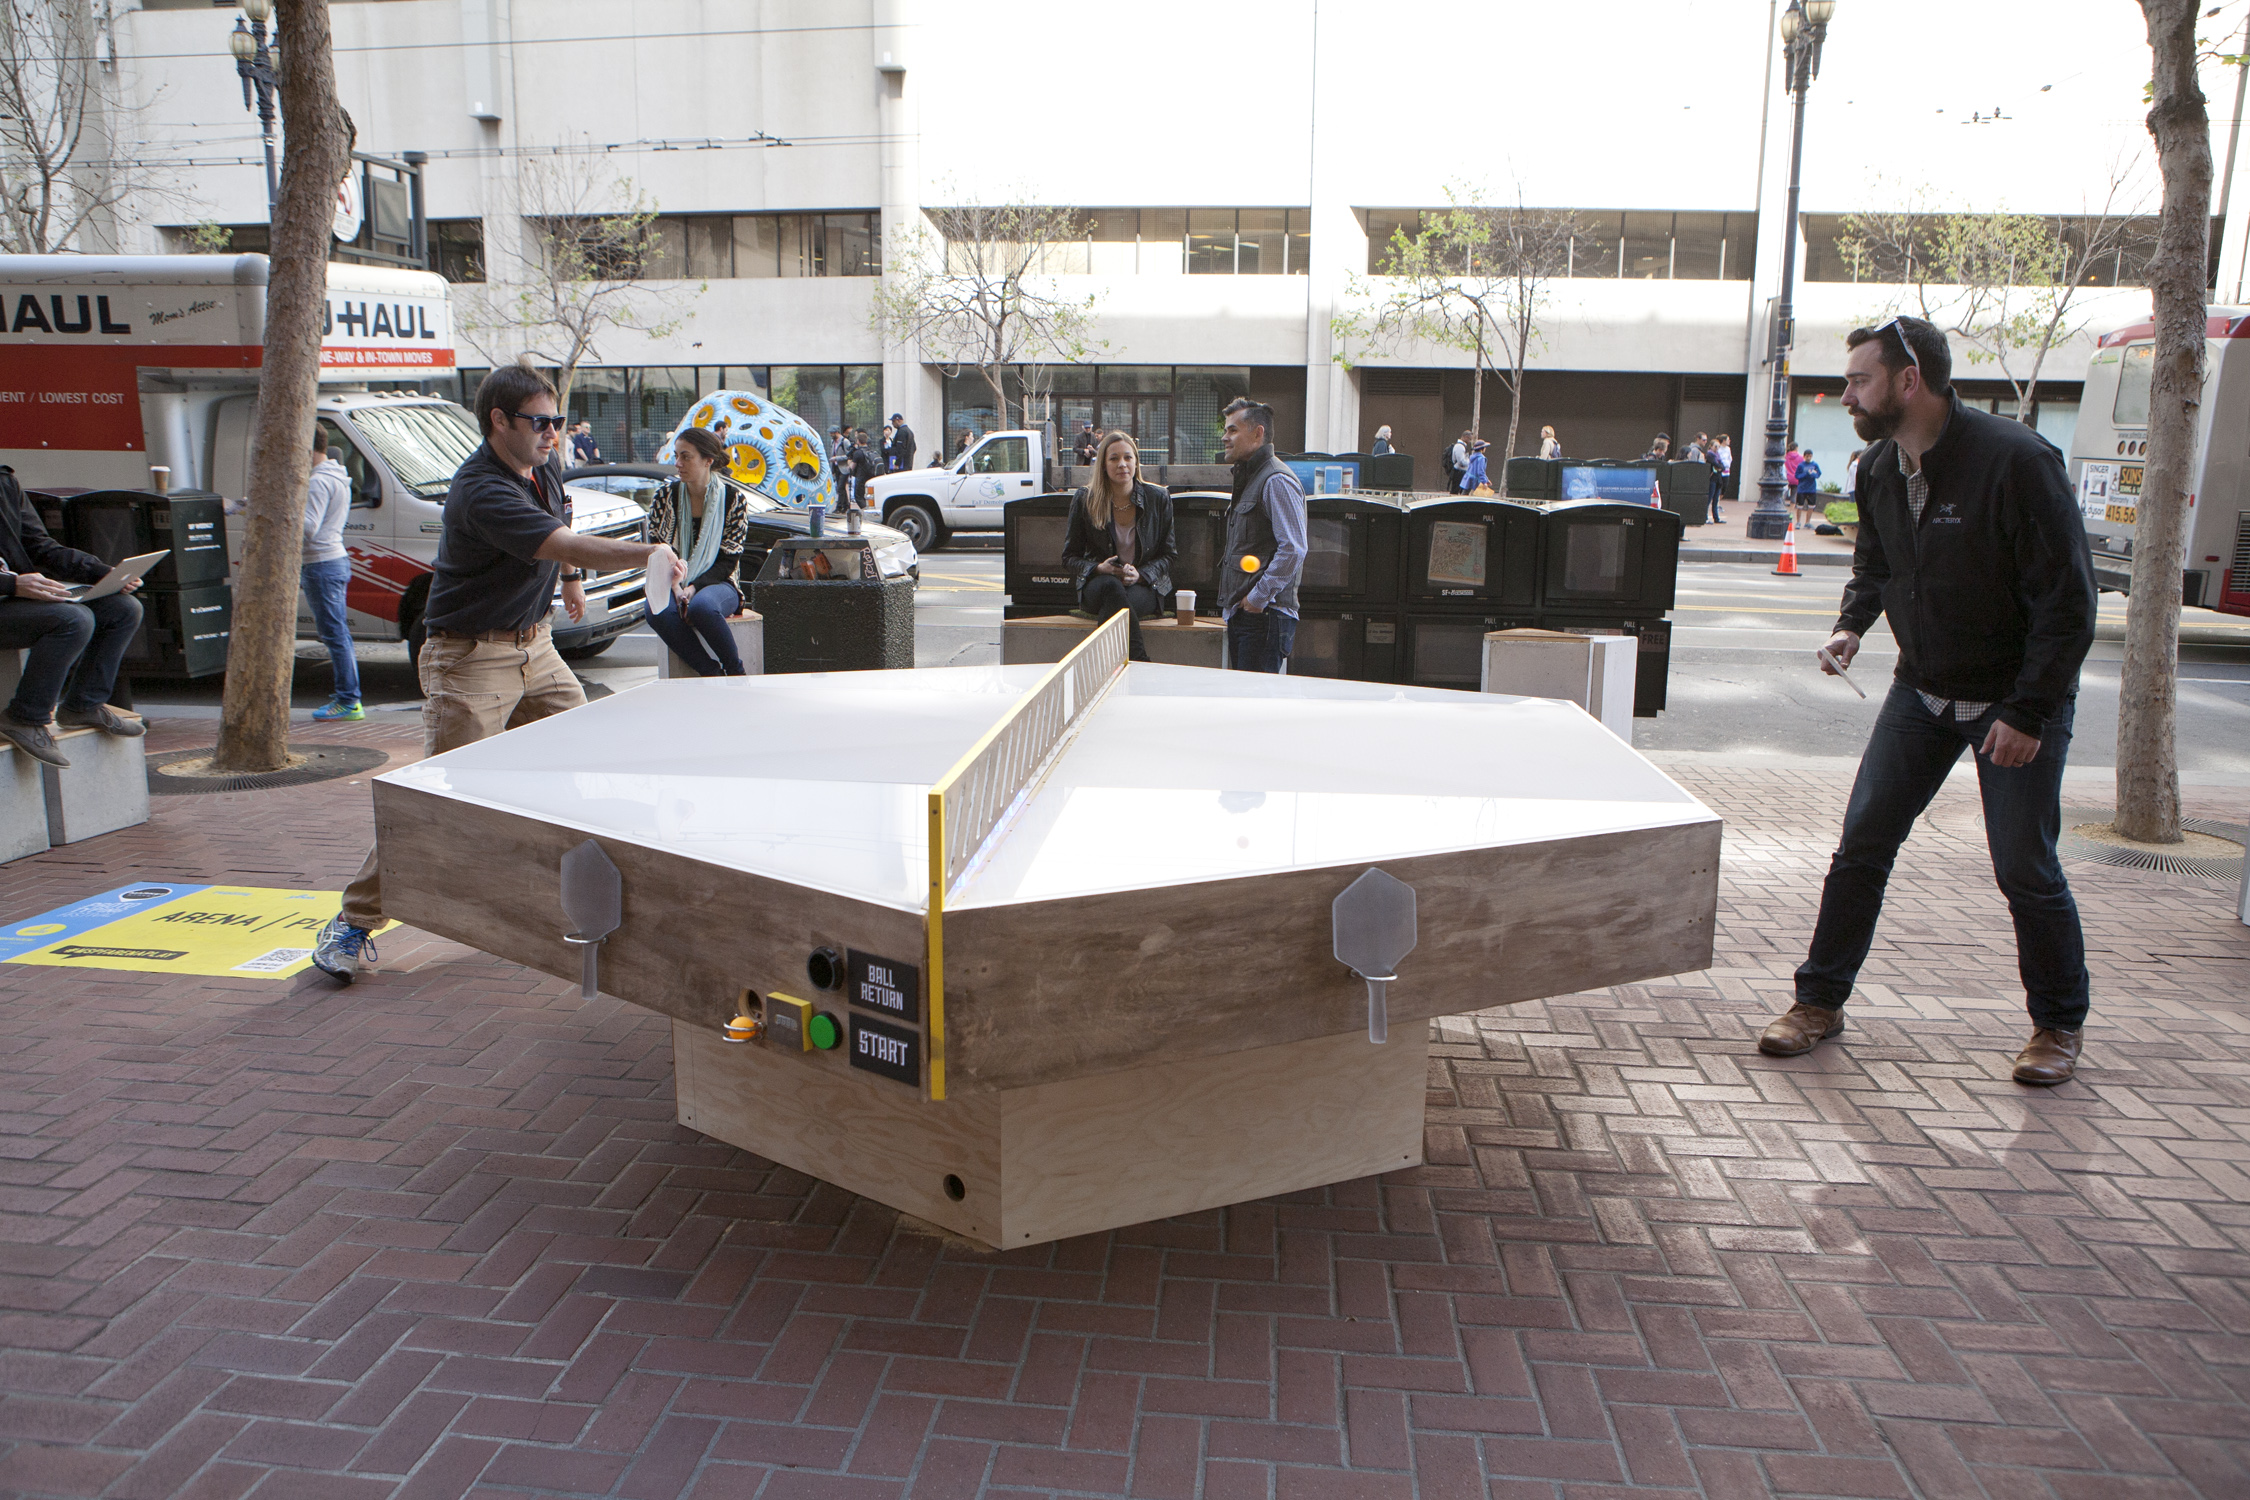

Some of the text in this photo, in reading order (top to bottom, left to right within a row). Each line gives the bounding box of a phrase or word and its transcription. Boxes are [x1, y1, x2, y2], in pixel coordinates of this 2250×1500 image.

[0, 294, 132, 334] AUL
[320, 351, 354, 364] NE-WAY
[404, 353, 433, 364] MOVES
[0, 392, 25, 402] ENT
[39, 393, 88, 404] LOWEST
[92, 393, 125, 405] COST
[2089, 464, 2109, 473] SINGER
[2120, 467, 2143, 485] SUNS
[2088, 505, 2104, 518] dyson
[2106, 505, 2136, 523] 415.56
[1622, 518, 1634, 526] PULL
[1642, 633, 1664, 644] FREE
[151, 911, 263, 926] ARENA
[868, 964, 896, 988] BALL
[861, 982, 904, 1011] RETURN
[858, 1028, 908, 1067] START
